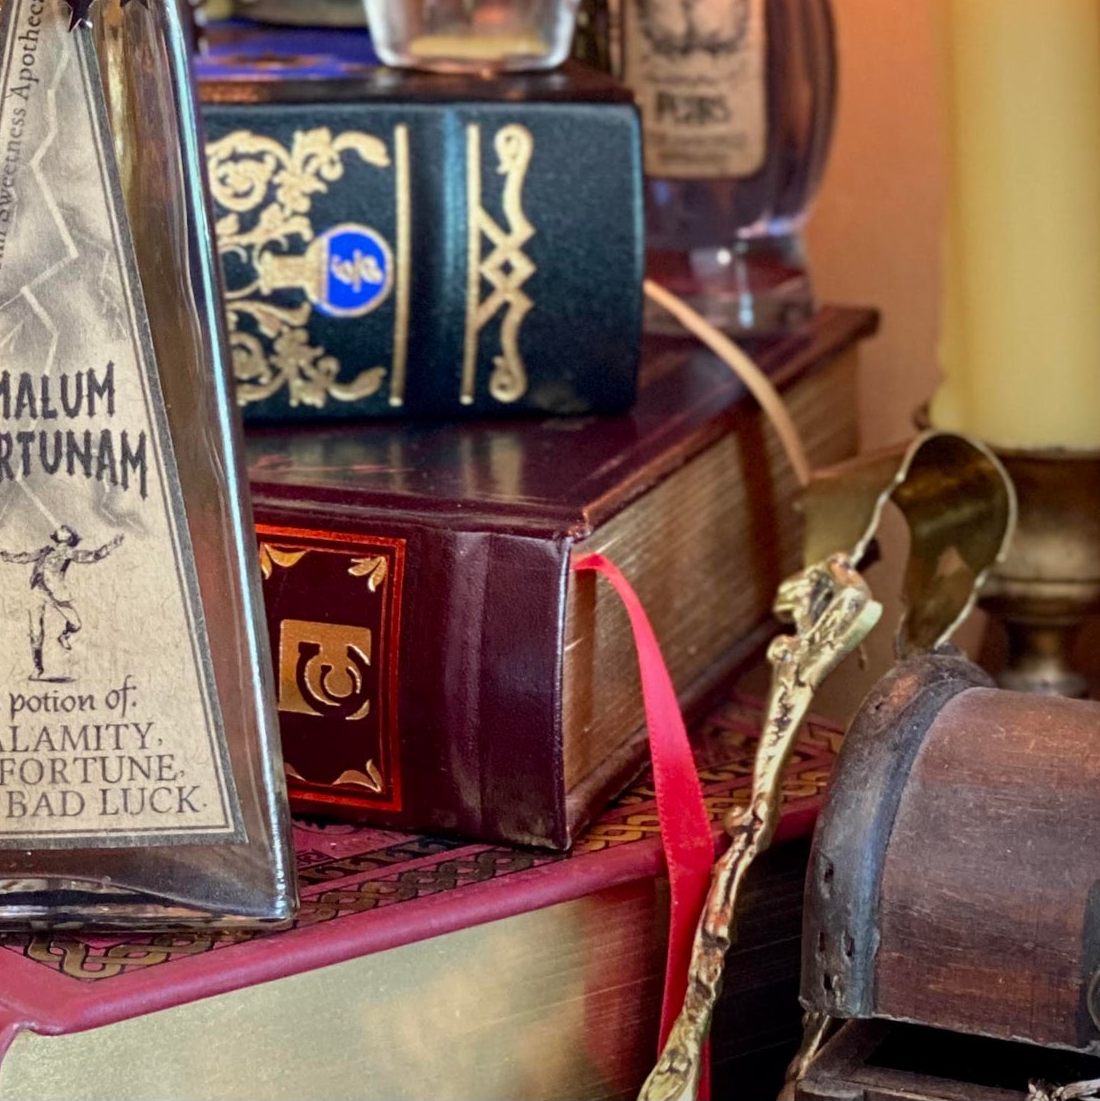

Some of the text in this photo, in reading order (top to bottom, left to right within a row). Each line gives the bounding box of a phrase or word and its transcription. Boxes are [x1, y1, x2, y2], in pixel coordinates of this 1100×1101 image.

[8, 689, 97, 719] potion
[5, 788, 86, 819] BAD
[99, 784, 209, 816] LUCK.
